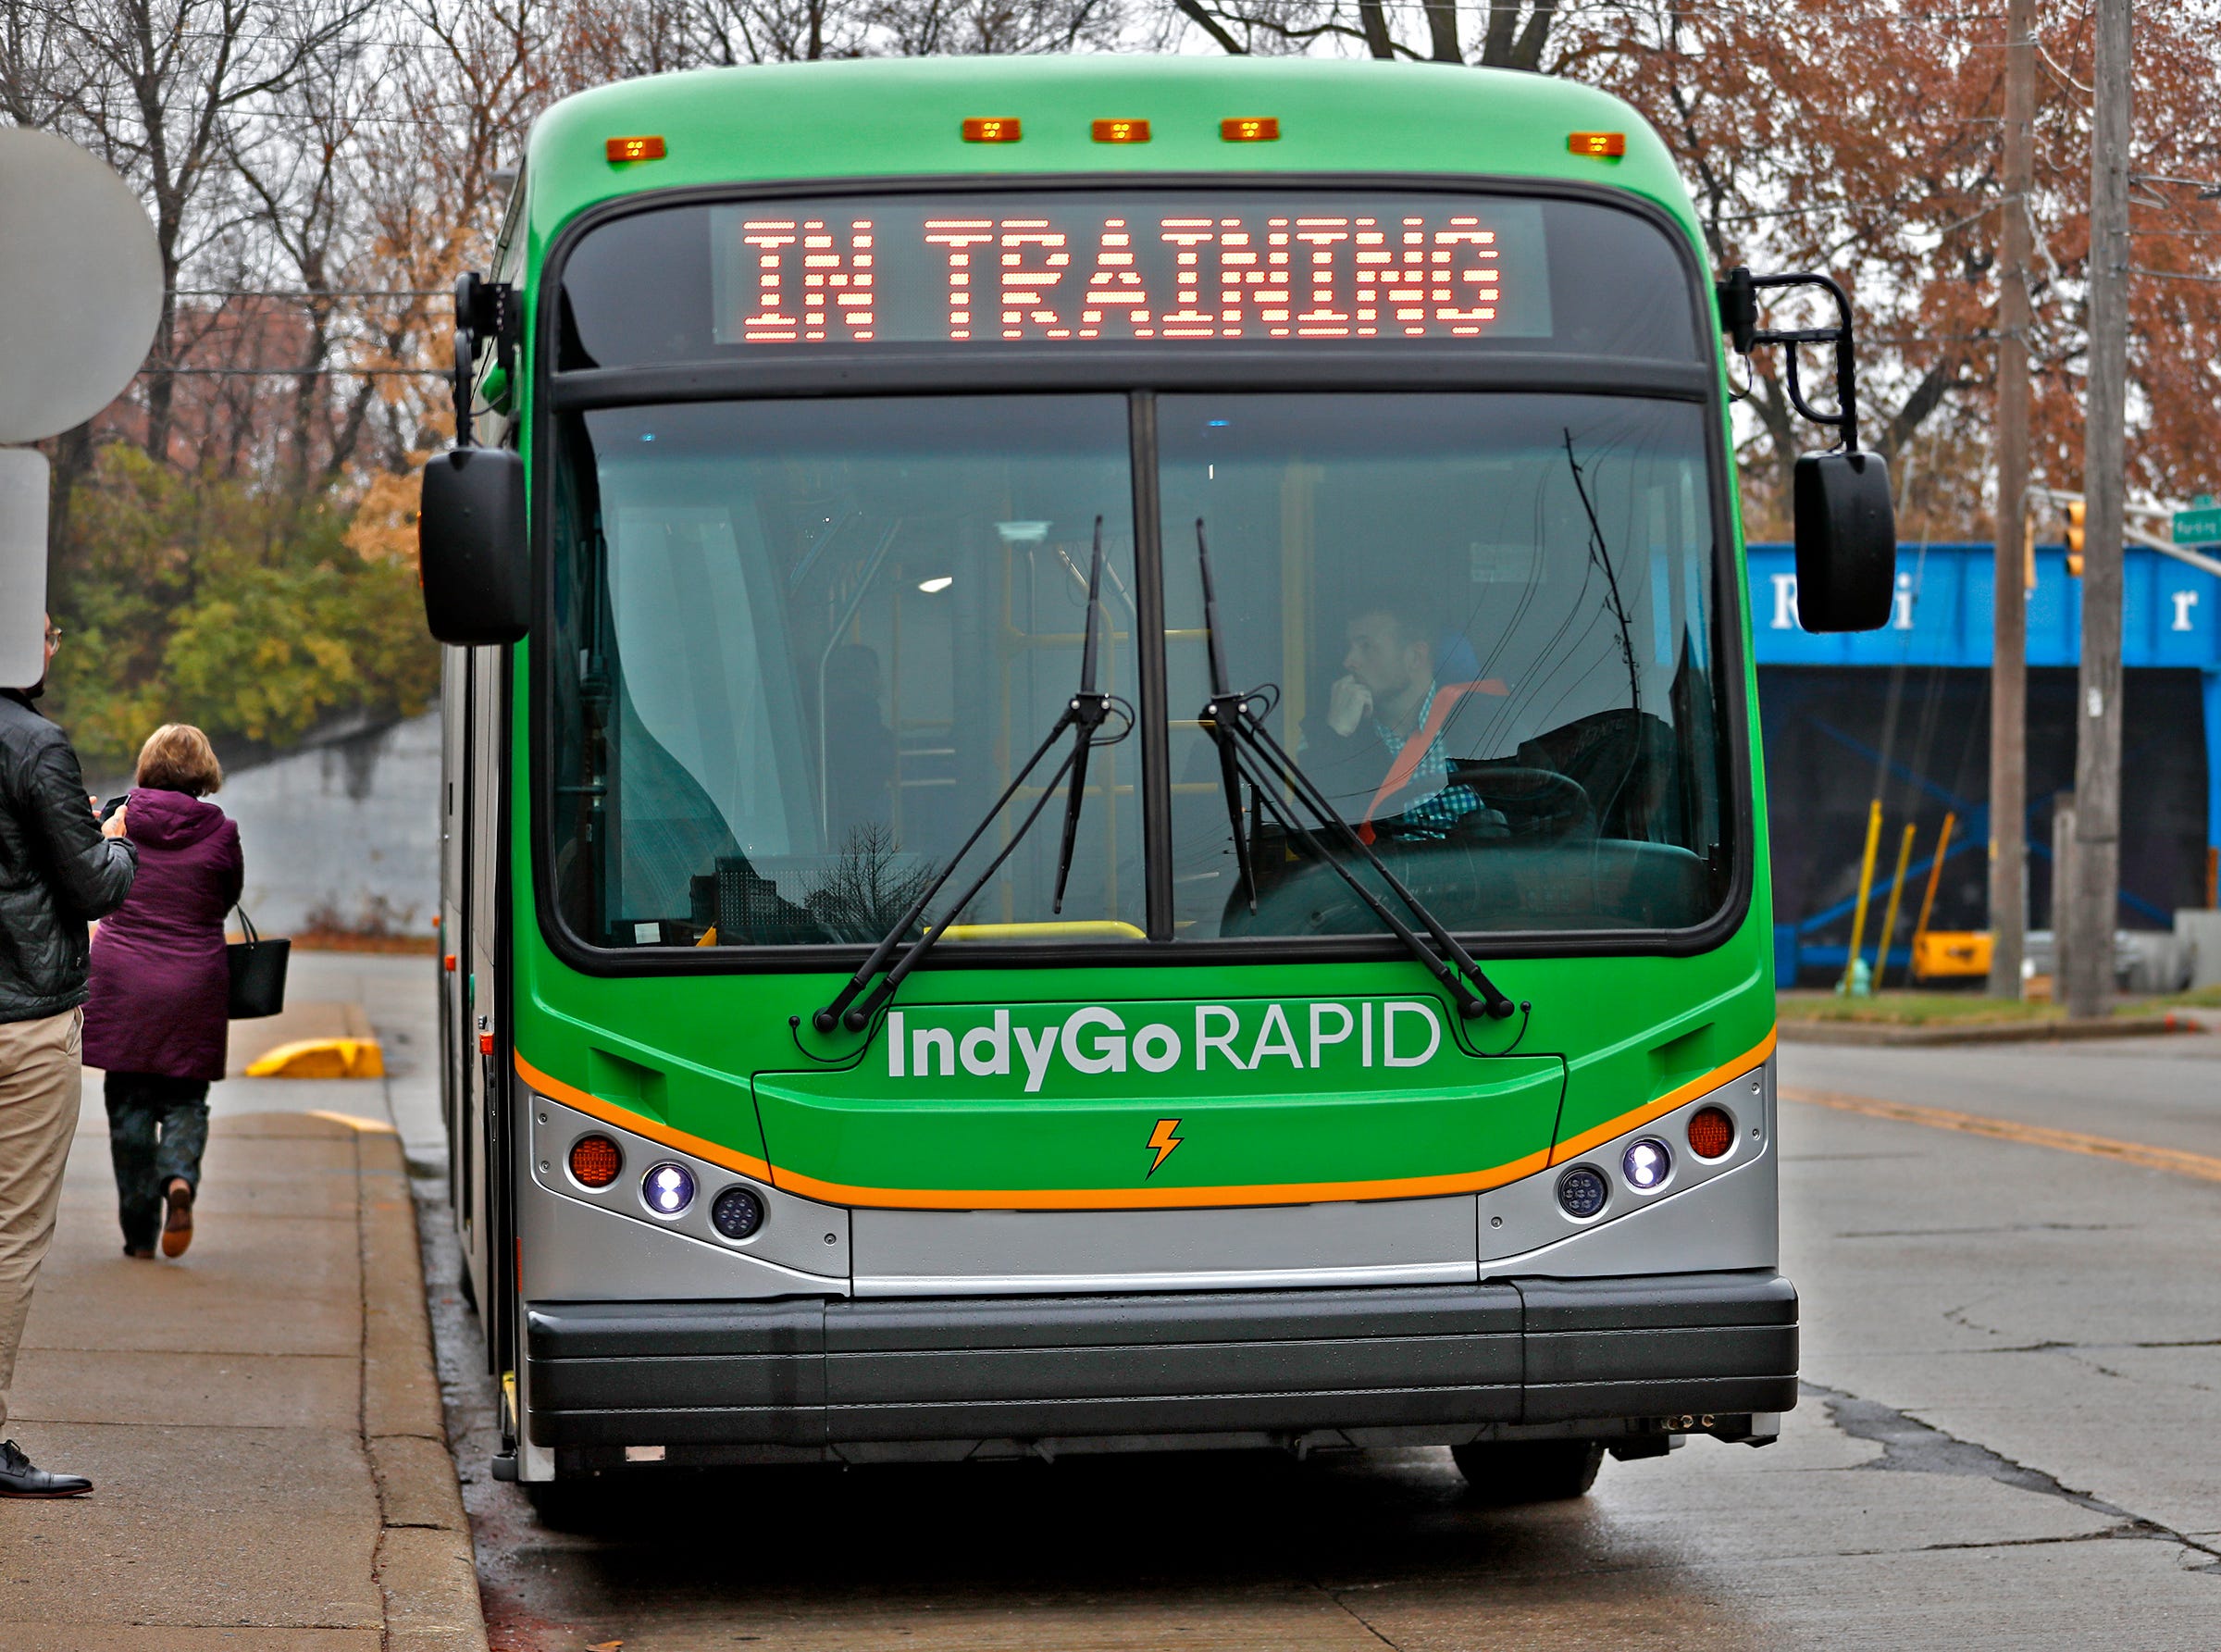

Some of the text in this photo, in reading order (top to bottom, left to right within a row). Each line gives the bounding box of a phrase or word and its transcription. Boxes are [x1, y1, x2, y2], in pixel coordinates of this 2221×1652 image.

[742, 217, 1500, 342] IN TRAINING
[887, 1001, 1442, 1092] IndyGo RAPID
